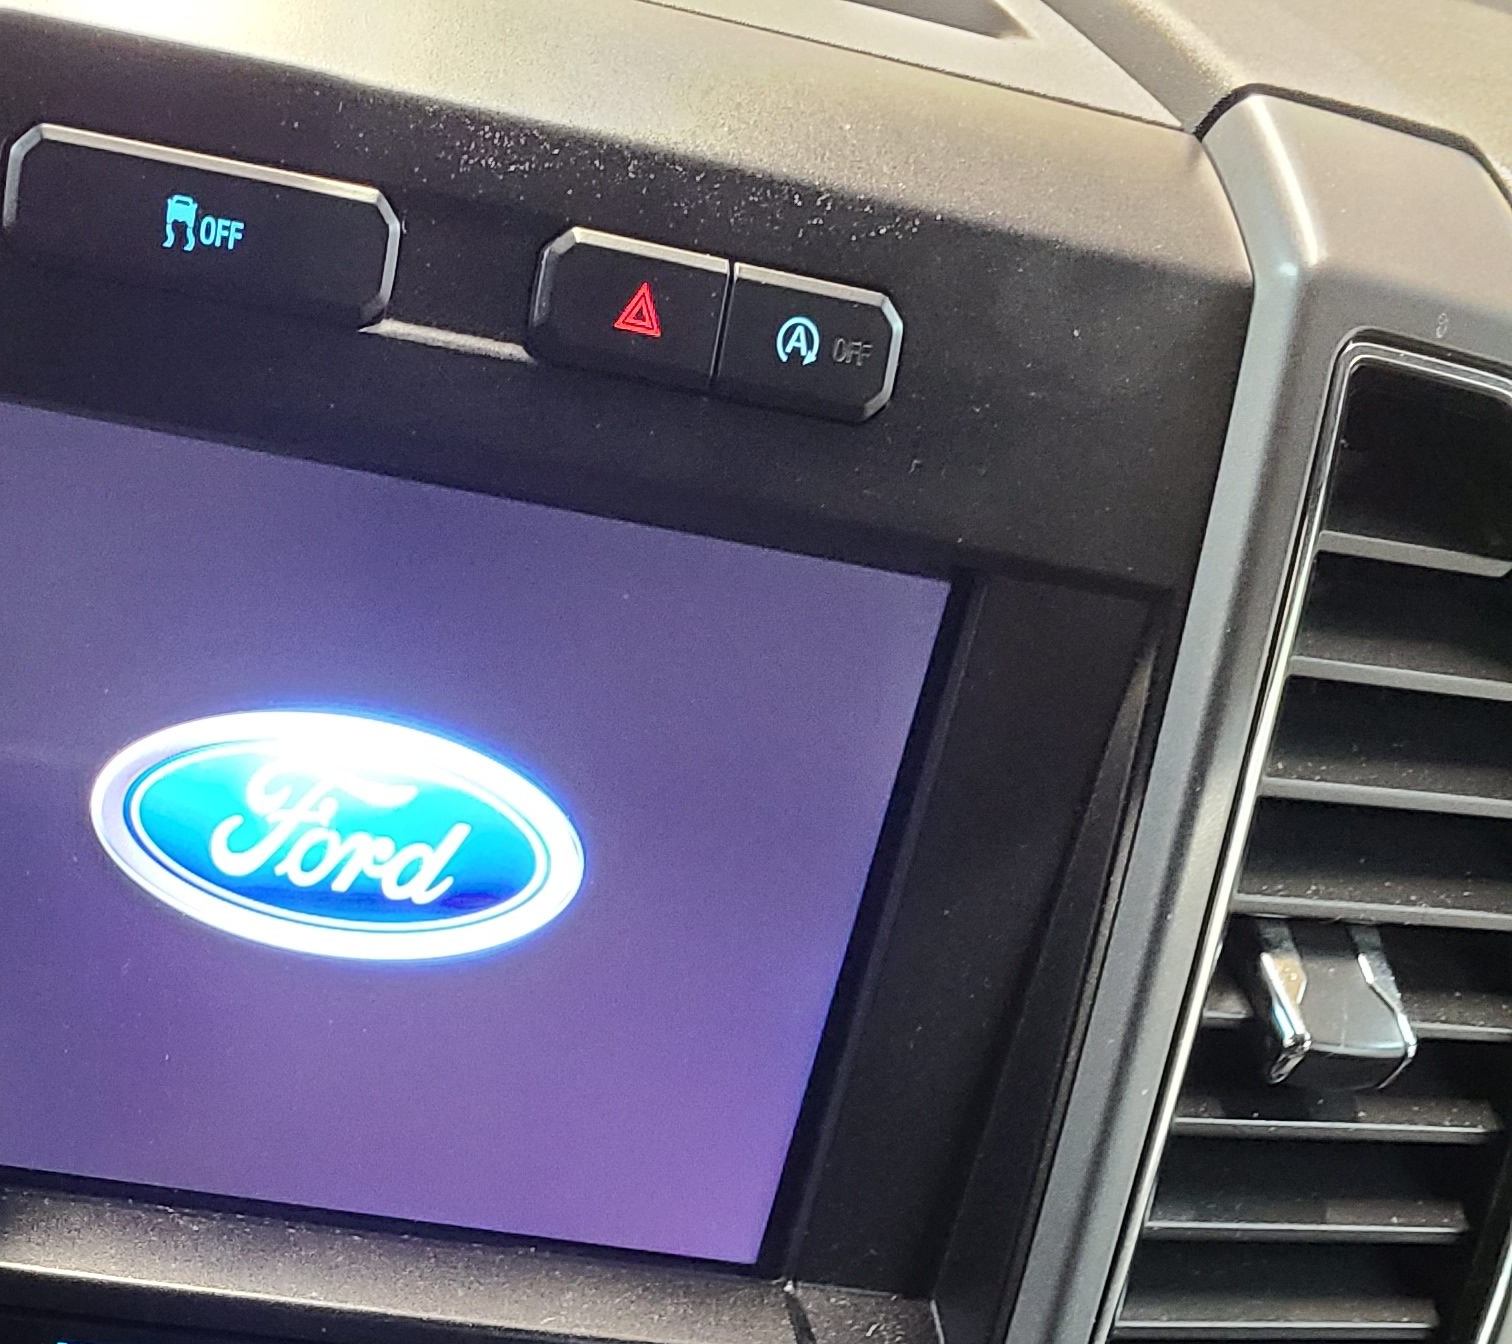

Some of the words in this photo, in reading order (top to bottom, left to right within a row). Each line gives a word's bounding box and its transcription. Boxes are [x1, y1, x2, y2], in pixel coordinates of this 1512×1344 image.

[199, 215, 245, 250] OFF
[832, 337, 874, 366] OFF
[209, 758, 472, 905] Ford
